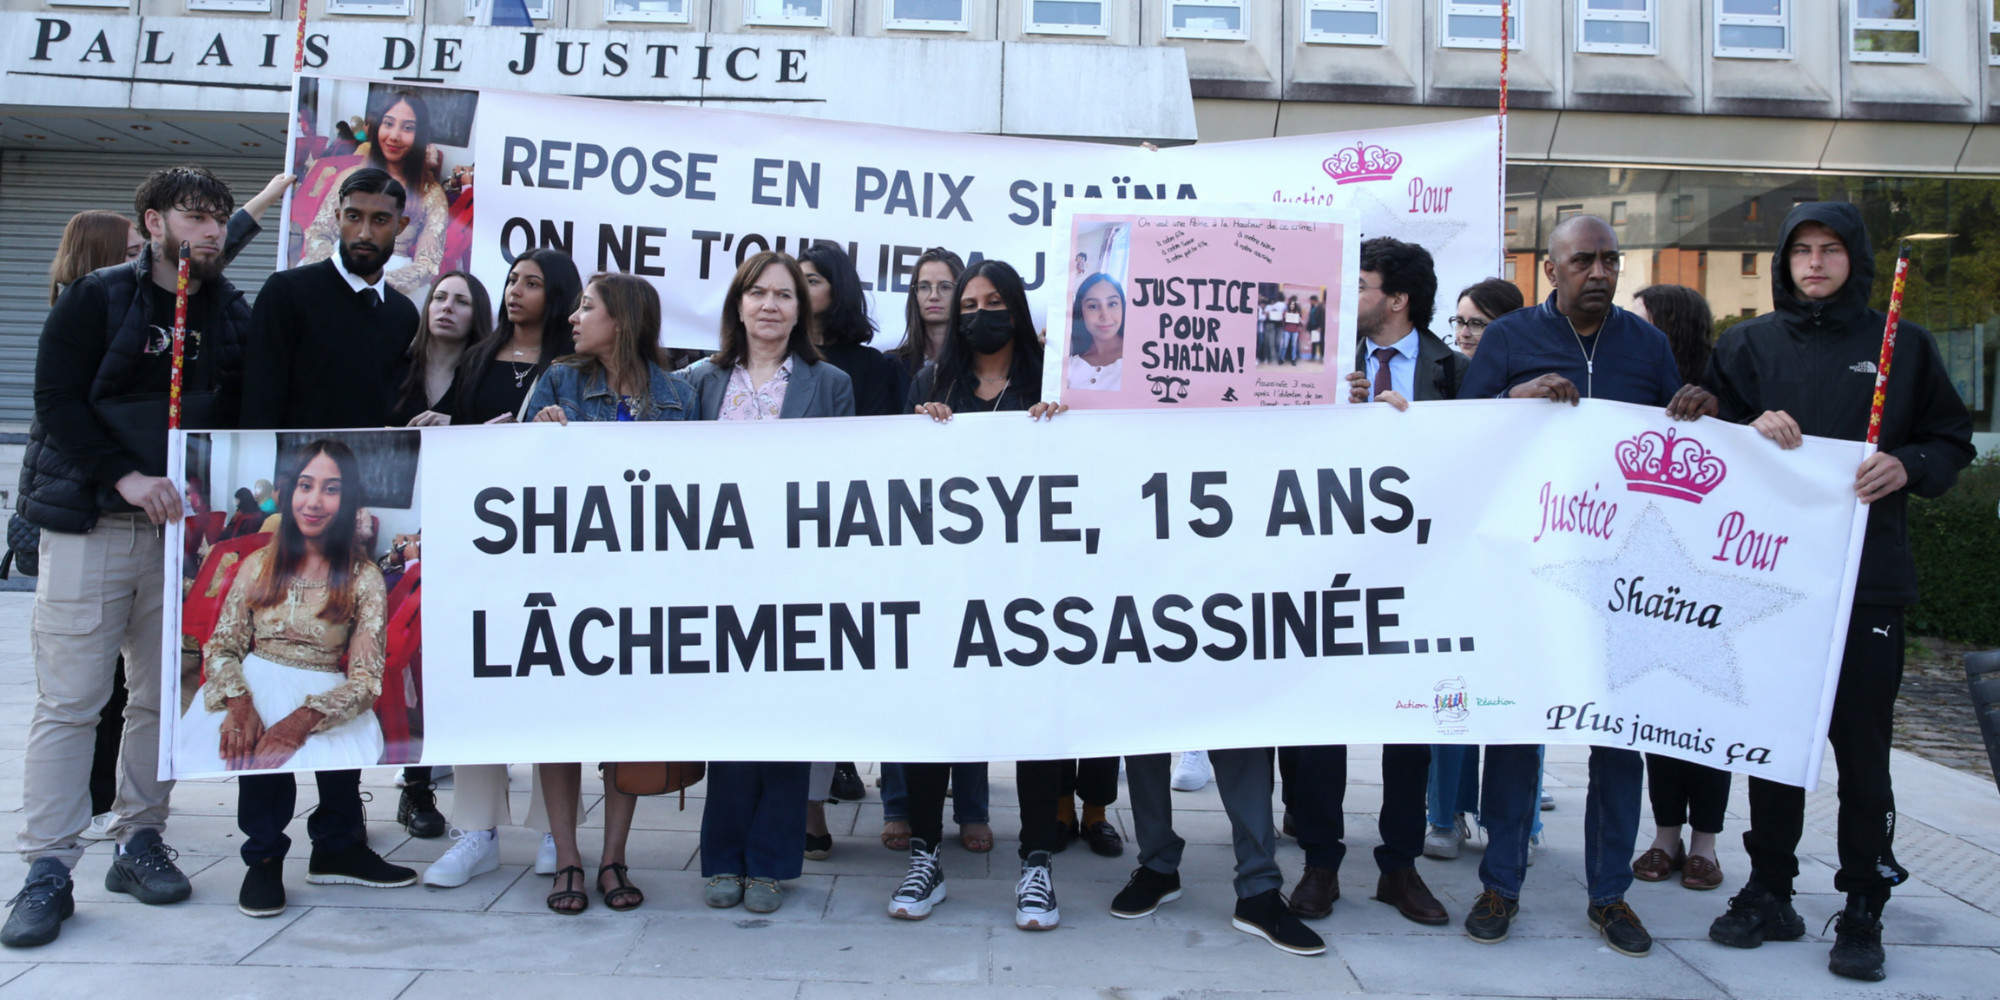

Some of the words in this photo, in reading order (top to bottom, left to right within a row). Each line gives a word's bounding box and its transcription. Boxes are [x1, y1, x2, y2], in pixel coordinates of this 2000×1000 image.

[29, 18, 330, 69] PALAIS
[379, 36, 463, 73] DE
[508, 32, 808, 84] JUSTICE
[501, 136, 718, 202] REPOSE
[752, 158, 821, 209] EN
[854, 166, 976, 222] PAIX
[1408, 177, 1453, 213] Pour
[1138, 217, 1151, 228] On
[1221, 218, 1229, 228] la
[1266, 220, 1277, 230] de
[597, 223, 668, 277] NE
[1132, 276, 1256, 314] JUSTICE
[1159, 313, 1221, 342] POUR
[1141, 341, 1245, 374] SHAÏNA!
[1292, 380, 1298, 388] 3
[1305, 391, 1312, 399] de
[472, 469, 755, 555] SHAÏNA
[786, 473, 1101, 554] HANSYE,
[1141, 471, 1234, 539] 15
[1265, 466, 1432, 545] ANS,
[1533, 481, 1618, 543] Justice
[1712, 511, 1789, 572] Pour
[1608, 576, 1723, 629] Shaïna
[472, 592, 921, 678] LÂCHEMENT
[953, 573, 1475, 668] ASSASSINÉE...
[1396, 700, 1429, 709] Action
[1476, 696, 1516, 706] Réaction
[1546, 702, 1624, 734] Plus
[1627, 714, 1716, 754] jamais
[1724, 742, 1772, 765] ça
